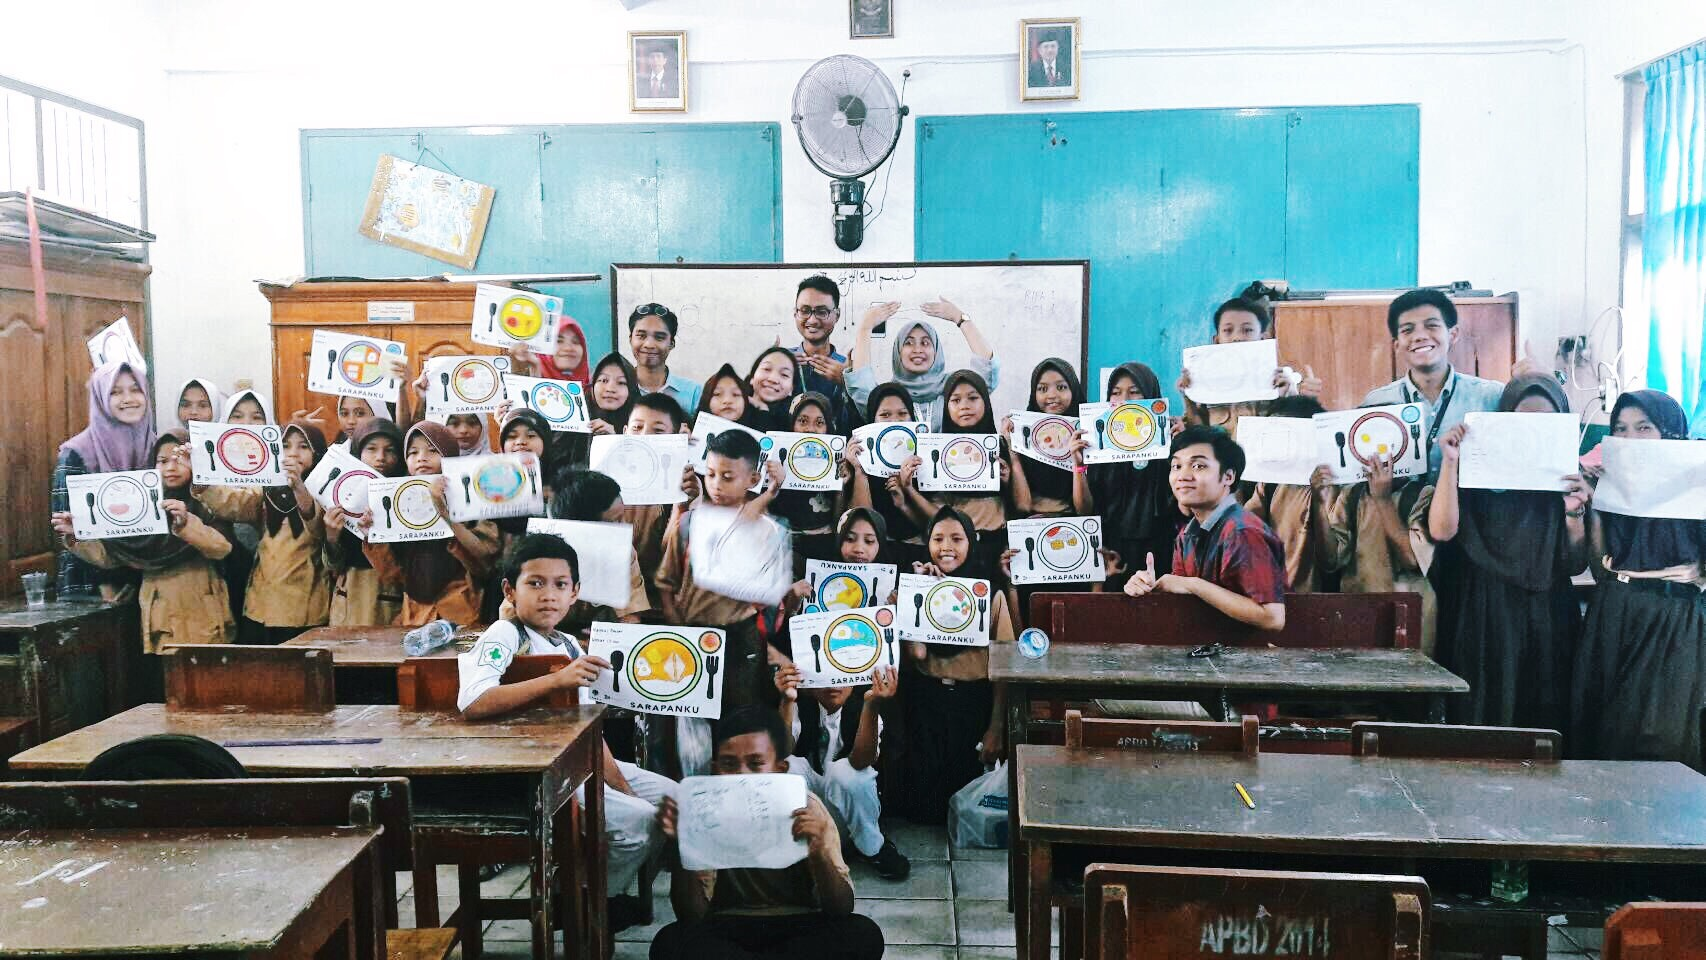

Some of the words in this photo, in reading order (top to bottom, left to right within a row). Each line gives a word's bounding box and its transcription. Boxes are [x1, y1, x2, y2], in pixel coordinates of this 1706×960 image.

[338, 387, 385, 399] SARAPANKU
[1112, 452, 1158, 460] SARAPANKU
[224, 477, 272, 485] SARAPANKU
[789, 482, 830, 490] SARAPANKU
[105, 526, 154, 536] SARAPANKU
[399, 531, 445, 540] SARAPANKU
[1042, 573, 1091, 581] SARAPANKU
[926, 634, 975, 644] SARAPANKU
[831, 673, 886, 685] SARAPAN
[630, 702, 699, 714] SARAPANKU
[1200, 914, 1269, 954] APBD
